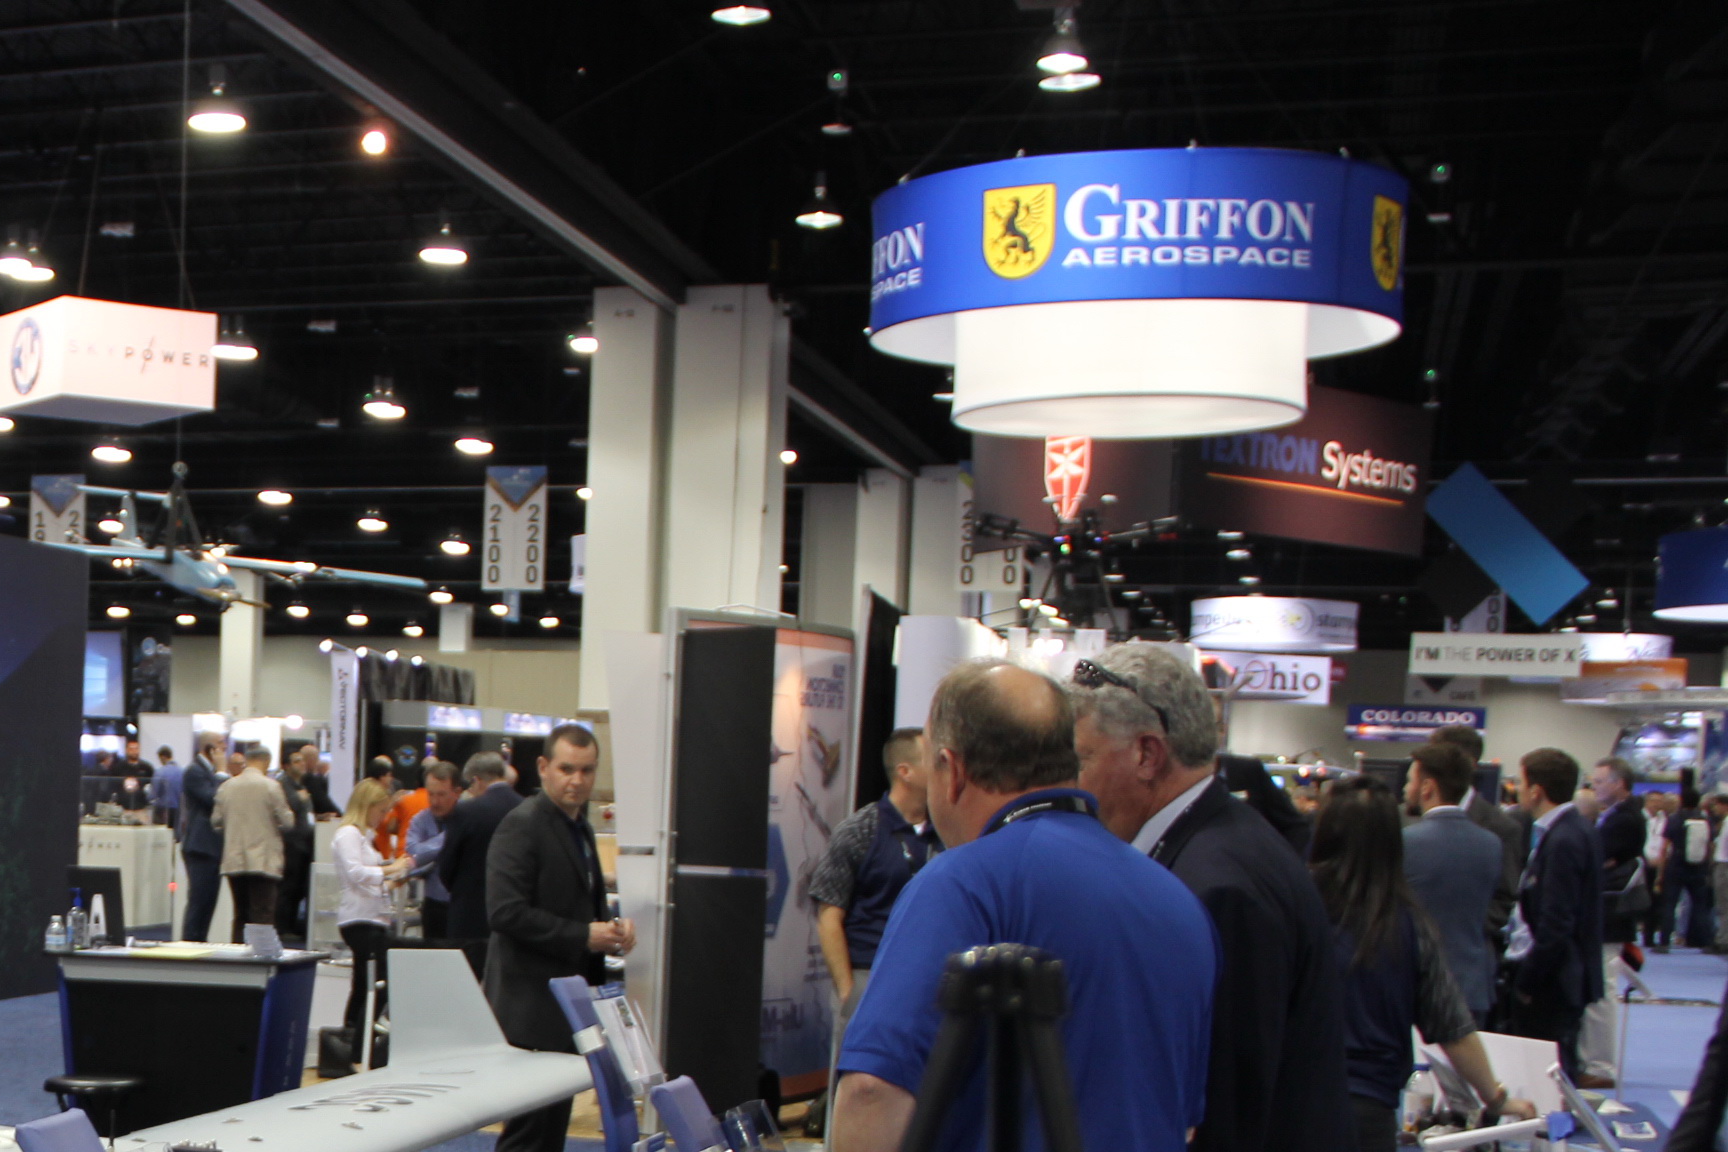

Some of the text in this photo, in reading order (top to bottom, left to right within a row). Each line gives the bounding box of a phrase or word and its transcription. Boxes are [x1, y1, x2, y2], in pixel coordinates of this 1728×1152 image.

[1063, 183, 1315, 243] GRIFFON
[1061, 245, 1313, 268] AEROSPACE
[1321, 440, 1418, 493] Systems
[1475, 647, 1534, 662] POWER
[1538, 648, 1561, 662] OF
[1563, 648, 1575, 662] X
[1360, 709, 1477, 724] COLORADO
